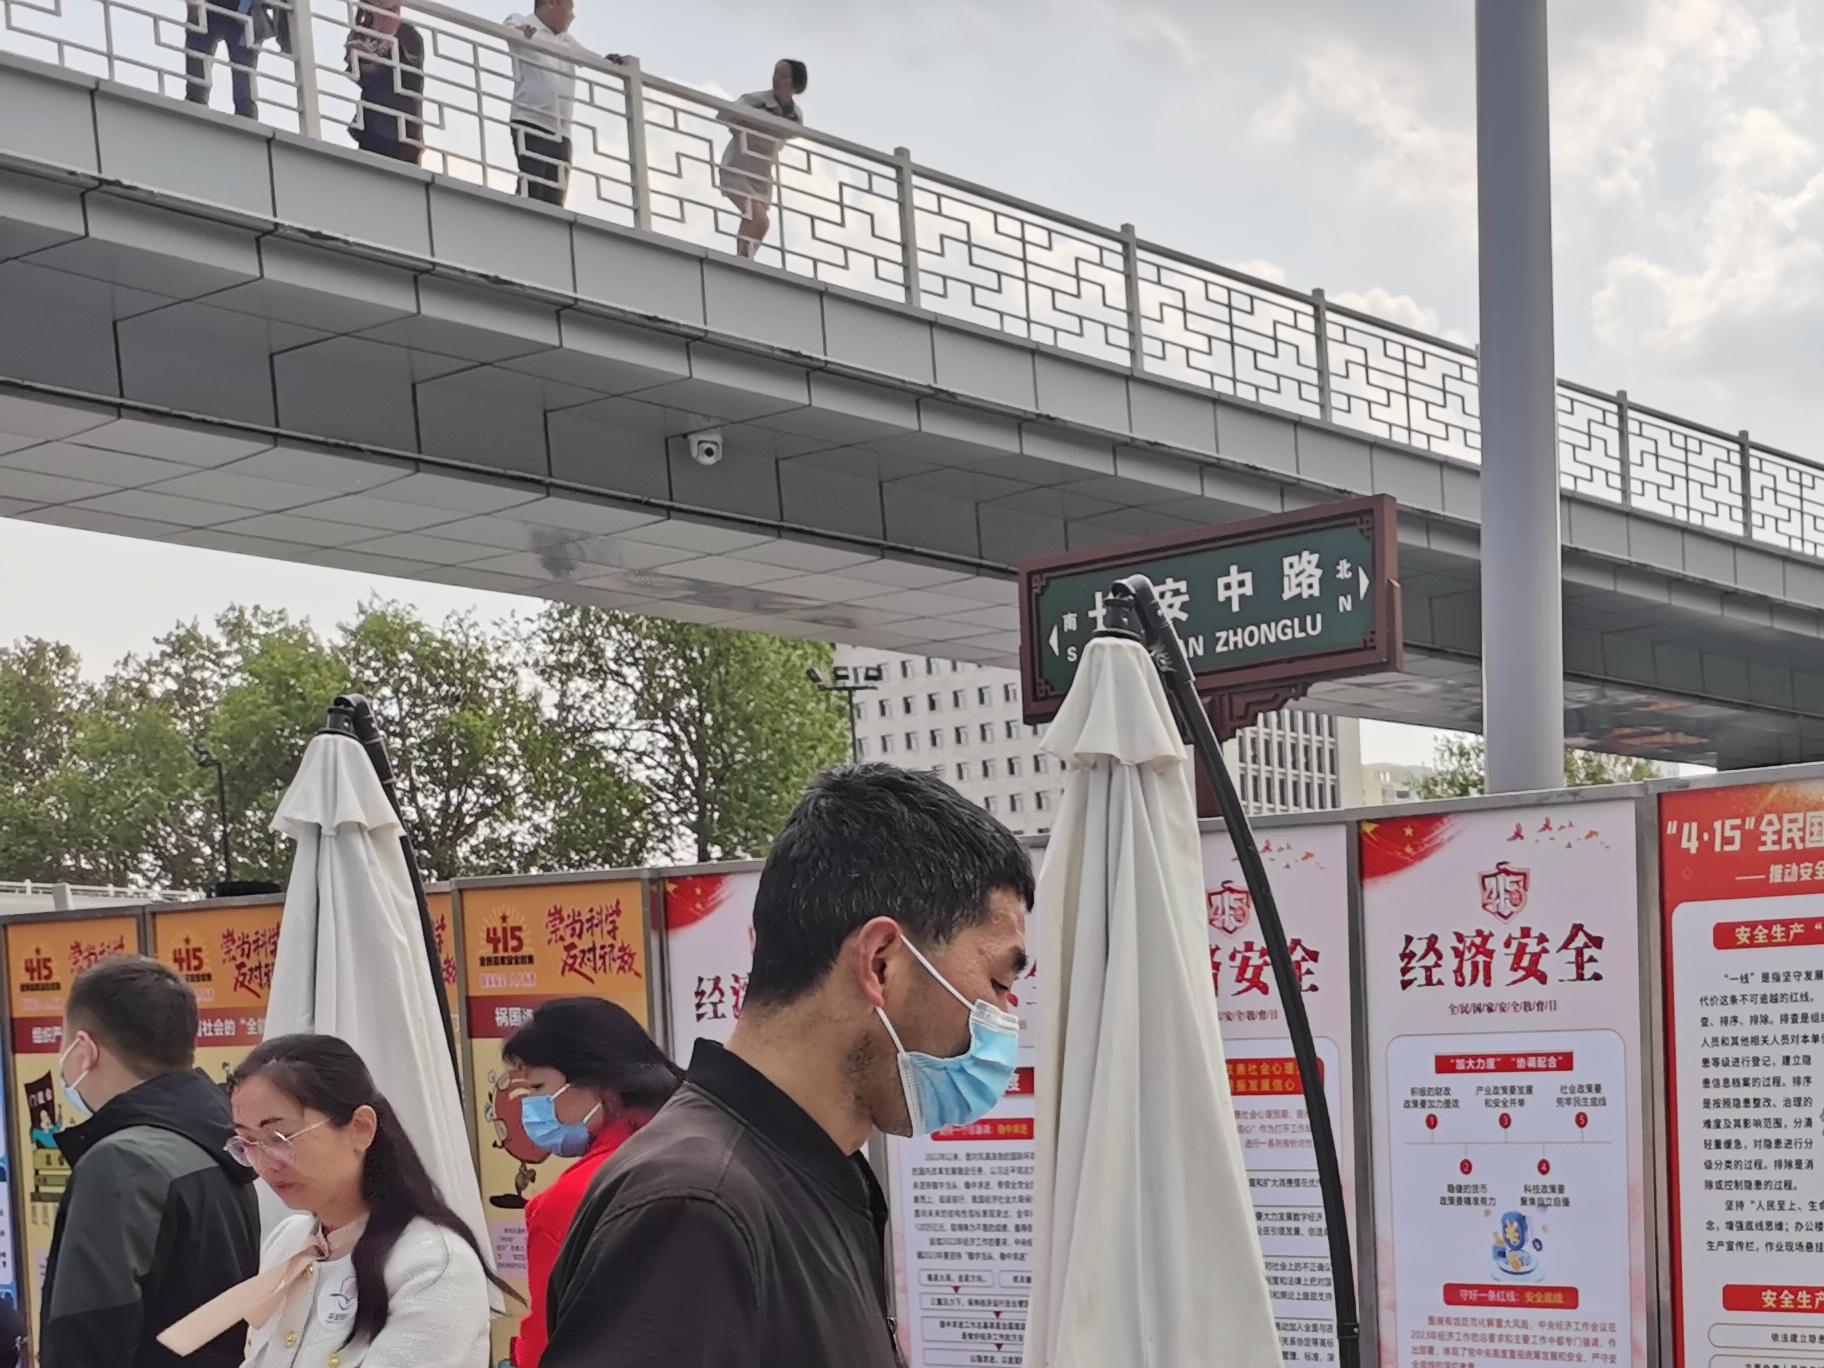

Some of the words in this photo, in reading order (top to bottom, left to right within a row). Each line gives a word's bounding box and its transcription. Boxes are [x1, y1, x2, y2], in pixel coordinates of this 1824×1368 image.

[1335, 559, 1353, 580] 北
[1338, 594, 1353, 612] N
[1062, 612, 1078, 632] 南
[1214, 613, 1323, 653] ZHONGLU
[1066, 645, 1078, 662] S
[545, 898, 622, 945] 崇尚科学
[486, 926, 524, 954] 415
[24, 957, 52, 981] 415
[173, 947, 204, 972] 415
[560, 940, 642, 985] 反对邪教
[1398, 923, 1605, 992] 经济安全
